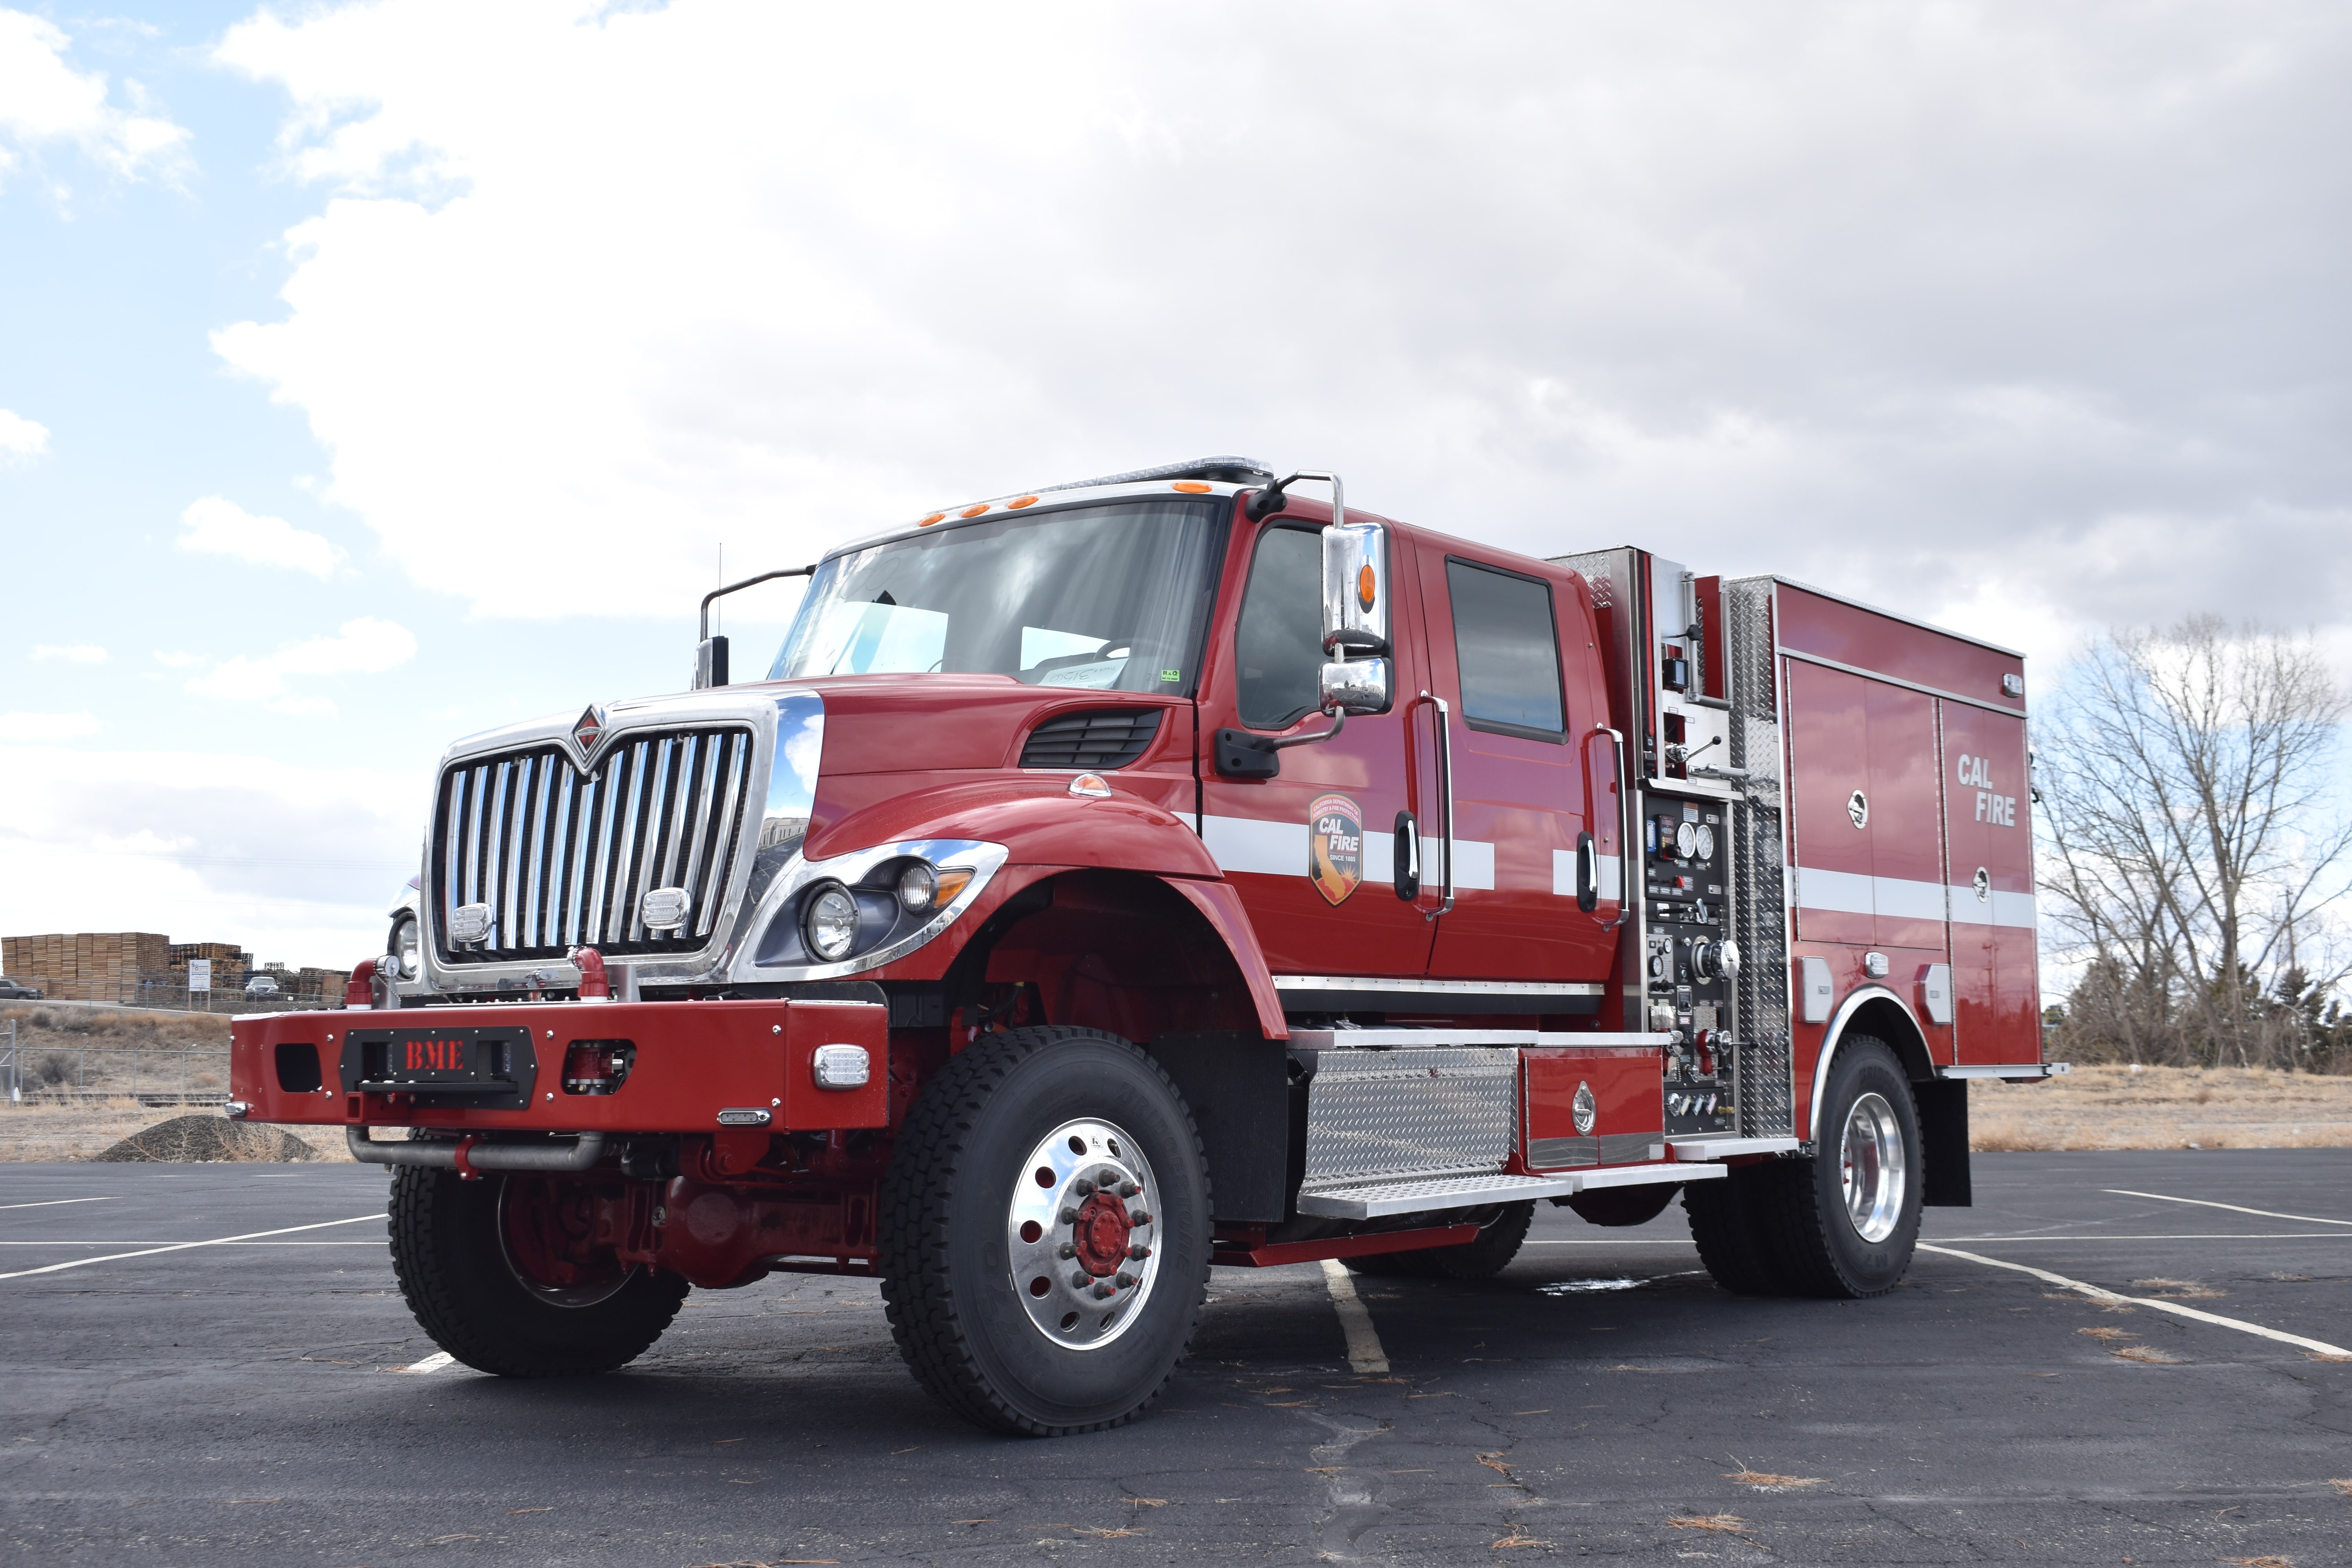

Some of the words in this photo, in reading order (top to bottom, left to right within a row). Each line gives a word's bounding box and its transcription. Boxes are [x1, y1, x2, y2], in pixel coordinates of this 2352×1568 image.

[1958, 754, 1993, 789] CAL
[1313, 806, 1328, 819] FORESTRY
[1340, 807, 1359, 824] PROTECTION
[1314, 799, 1332, 811] CALIFORNIA
[1333, 799, 1354, 812] DEPARTMENT
[1975, 791, 2016, 827] FIRE
[1319, 817, 1343, 834] CAL
[1330, 835, 1359, 851] FIRE
[405, 1040, 464, 1069] BME
[1114, 1081, 1193, 1277] BRIDGESTONE
